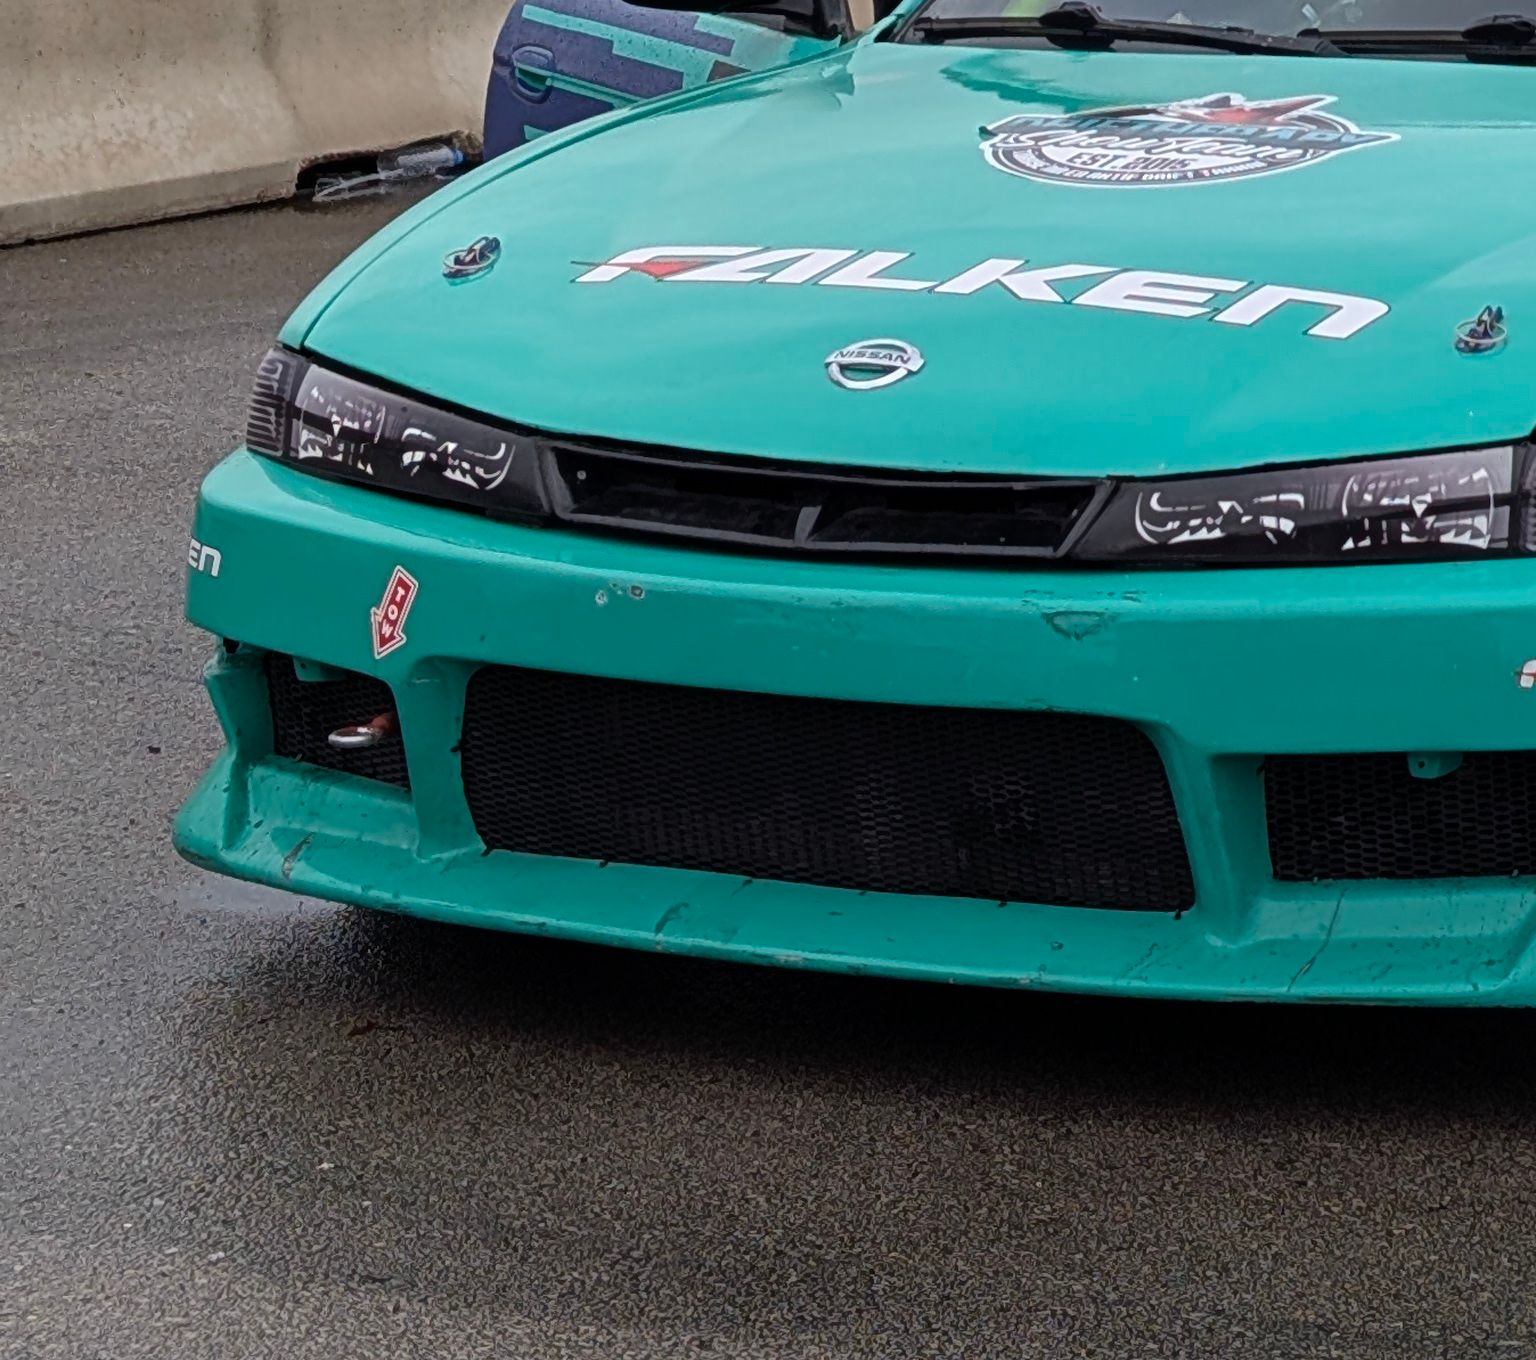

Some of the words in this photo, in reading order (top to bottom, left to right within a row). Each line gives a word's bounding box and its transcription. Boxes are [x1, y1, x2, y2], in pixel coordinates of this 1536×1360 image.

[571, 246, 1392, 339] FALKEN
[834, 349, 912, 365] NISSAN
[380, 585, 406, 638] TOW
